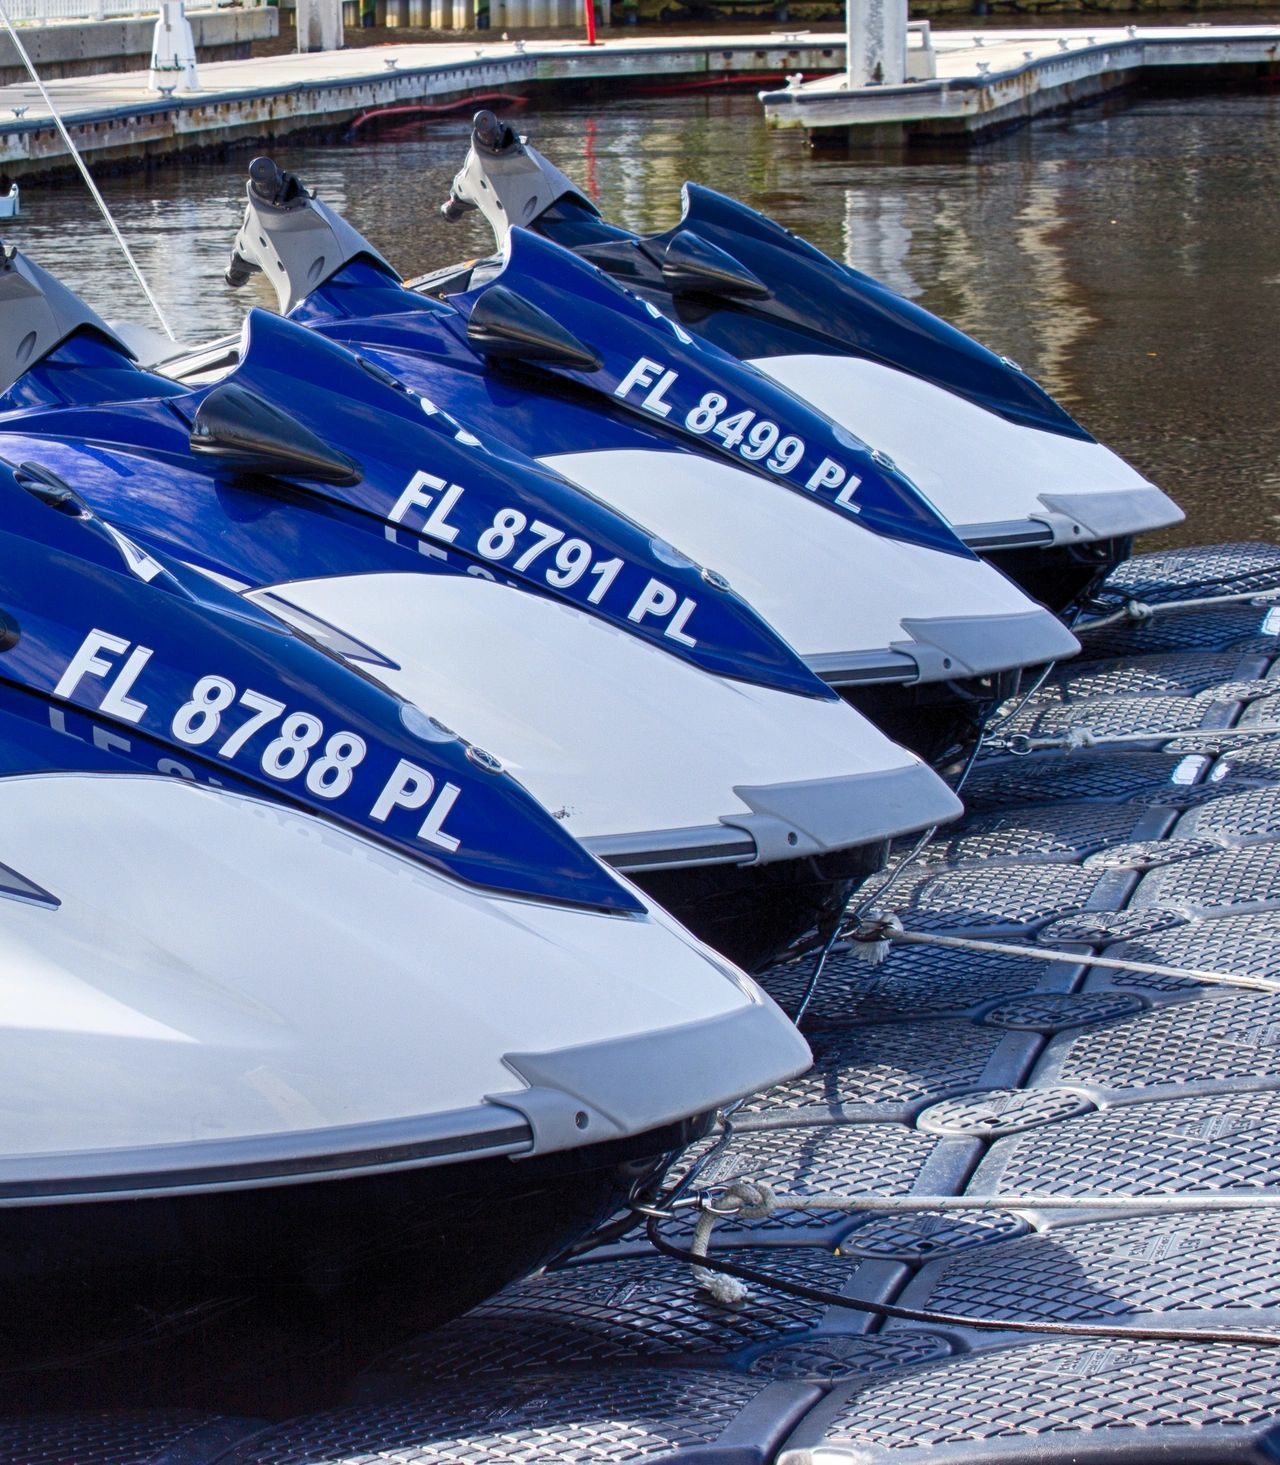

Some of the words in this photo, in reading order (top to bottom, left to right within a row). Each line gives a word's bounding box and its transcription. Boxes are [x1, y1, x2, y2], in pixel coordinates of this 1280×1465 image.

[613, 356, 679, 418] FL
[685, 391, 805, 475] 8499
[804, 456, 862, 515] PL
[387, 470, 465, 543] FL
[477, 508, 625, 605] 8791
[627, 577, 698, 648] PL
[50, 627, 154, 724] FL
[170, 674, 367, 799] 8788
[368, 757, 462, 853] PL
